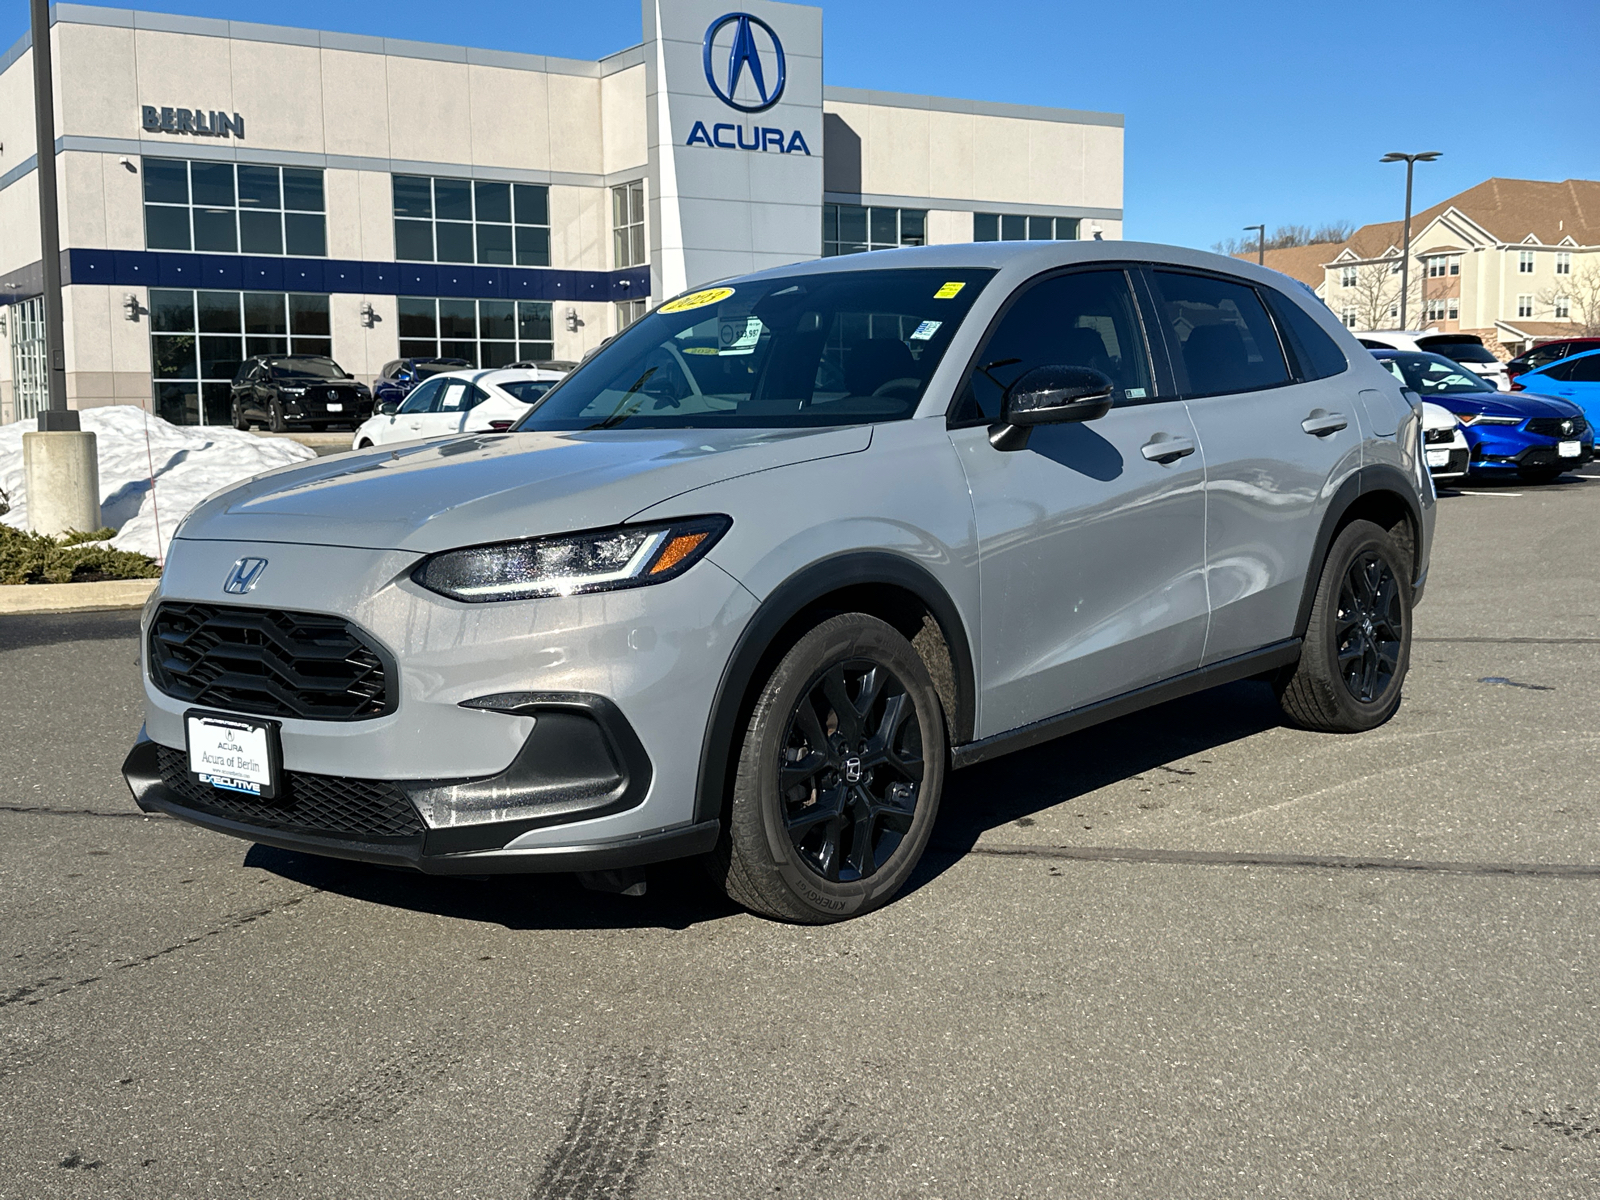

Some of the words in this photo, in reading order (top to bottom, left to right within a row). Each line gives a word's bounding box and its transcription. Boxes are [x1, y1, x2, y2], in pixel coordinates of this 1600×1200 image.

[142, 105, 244, 139] BERLIN
[686, 121, 811, 156] ACURA
[217, 742, 243, 753] ACURA
[202, 750, 225, 766] Acura
[226, 756, 235, 767] of
[237, 756, 260, 772] Berlin
[199, 773, 260, 793] EXECUTIVE
[795, 880, 807, 891] GT
[803, 889, 846, 911] KINERGY
